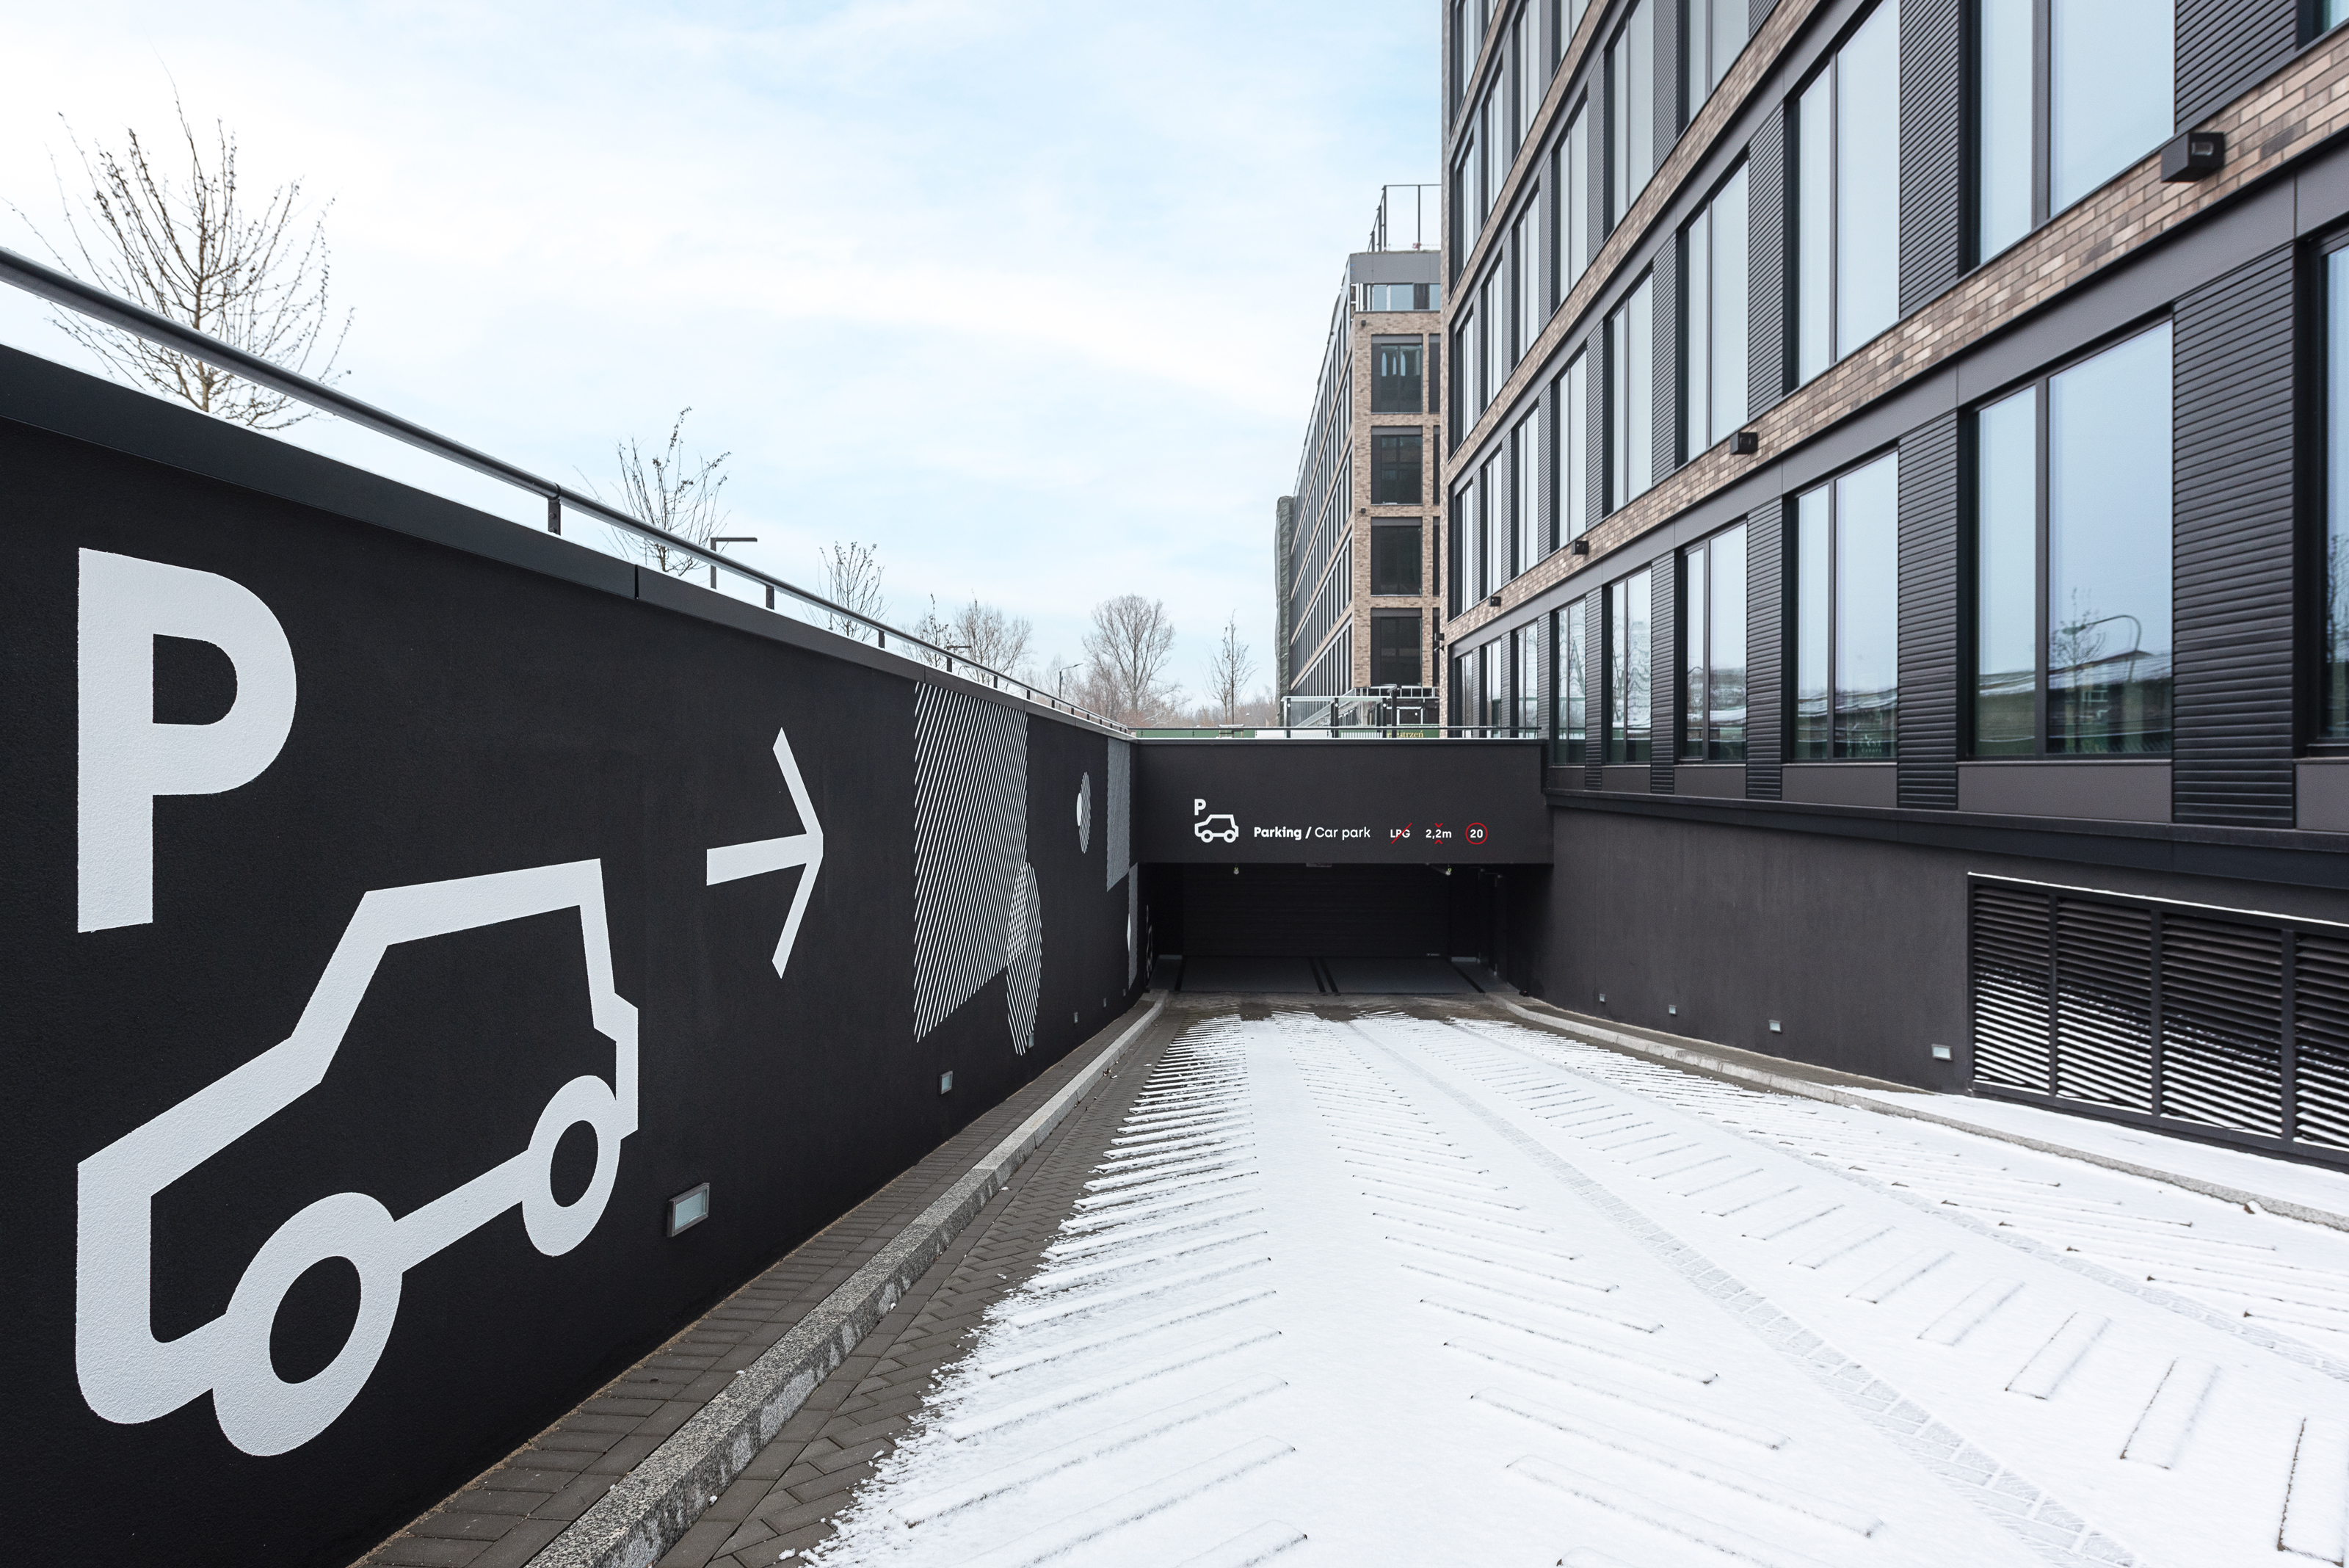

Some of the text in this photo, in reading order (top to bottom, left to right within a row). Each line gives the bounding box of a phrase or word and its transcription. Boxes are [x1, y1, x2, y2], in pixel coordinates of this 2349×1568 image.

[78, 548, 297, 933] P
[1194, 799, 1206, 816] P
[1255, 827, 1301, 840] Parking
[1315, 827, 1338, 838] Car
[1343, 827, 1370, 841] park
[1390, 830, 1410, 838] LPG
[1426, 830, 1451, 839] 2,2m
[1470, 830, 1483, 838] 20
